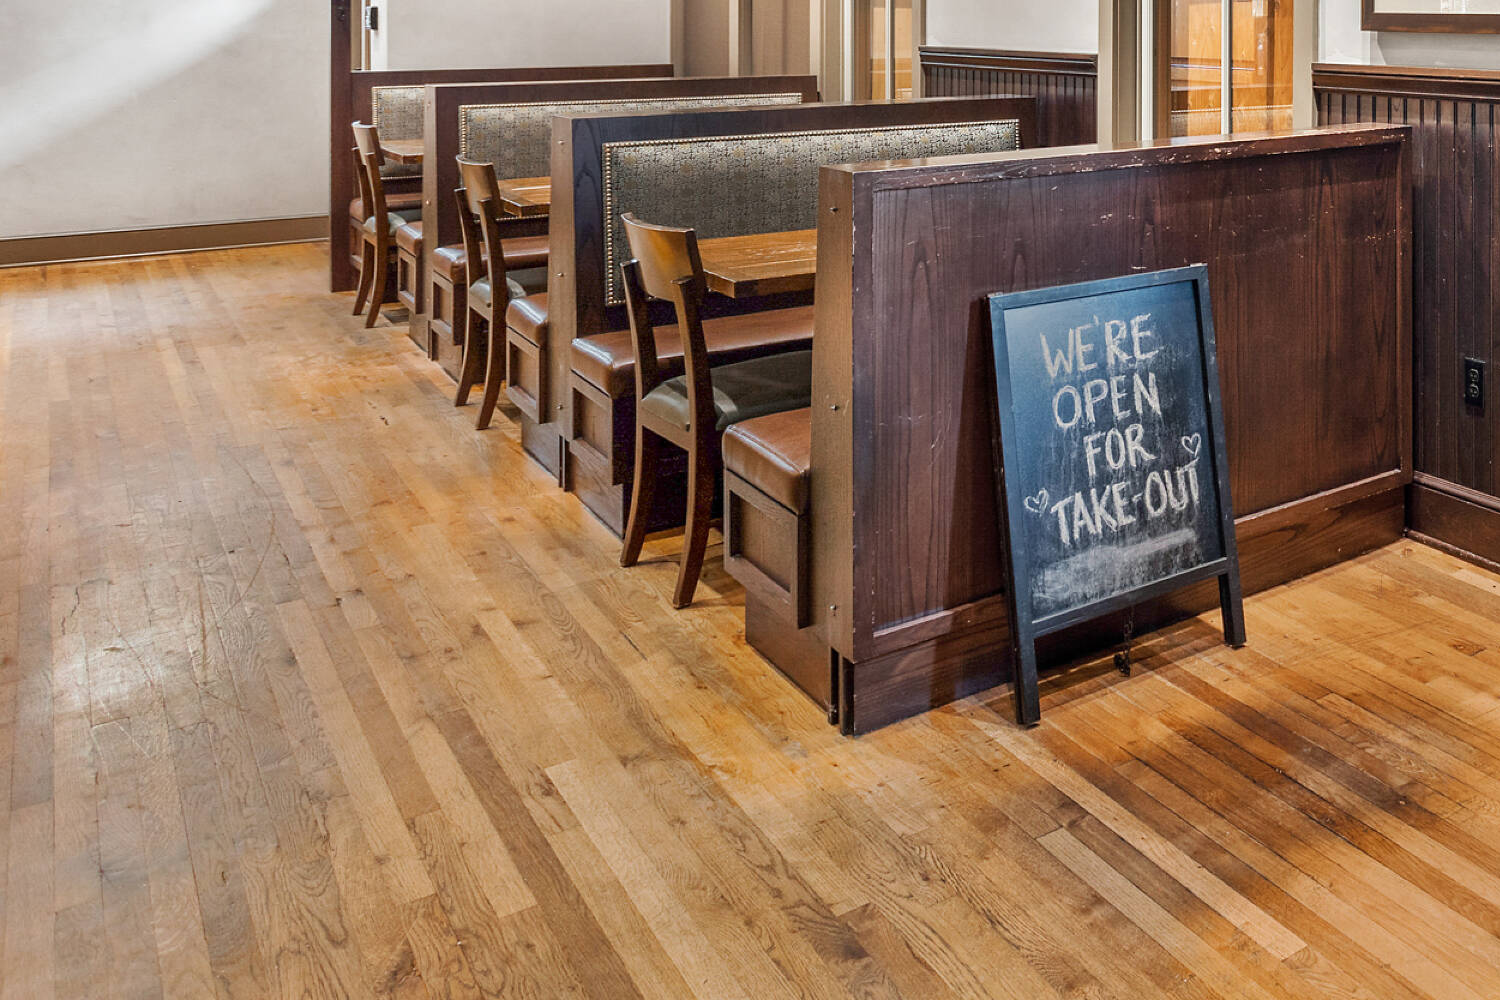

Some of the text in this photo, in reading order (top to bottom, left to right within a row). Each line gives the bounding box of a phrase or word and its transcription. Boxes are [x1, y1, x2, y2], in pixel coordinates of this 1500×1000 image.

[1040, 313, 1164, 379] WE'RE
[1052, 372, 1162, 430] OPEN
[1083, 423, 1159, 477] FOR
[1050, 457, 1201, 545] TAKE-OUT
